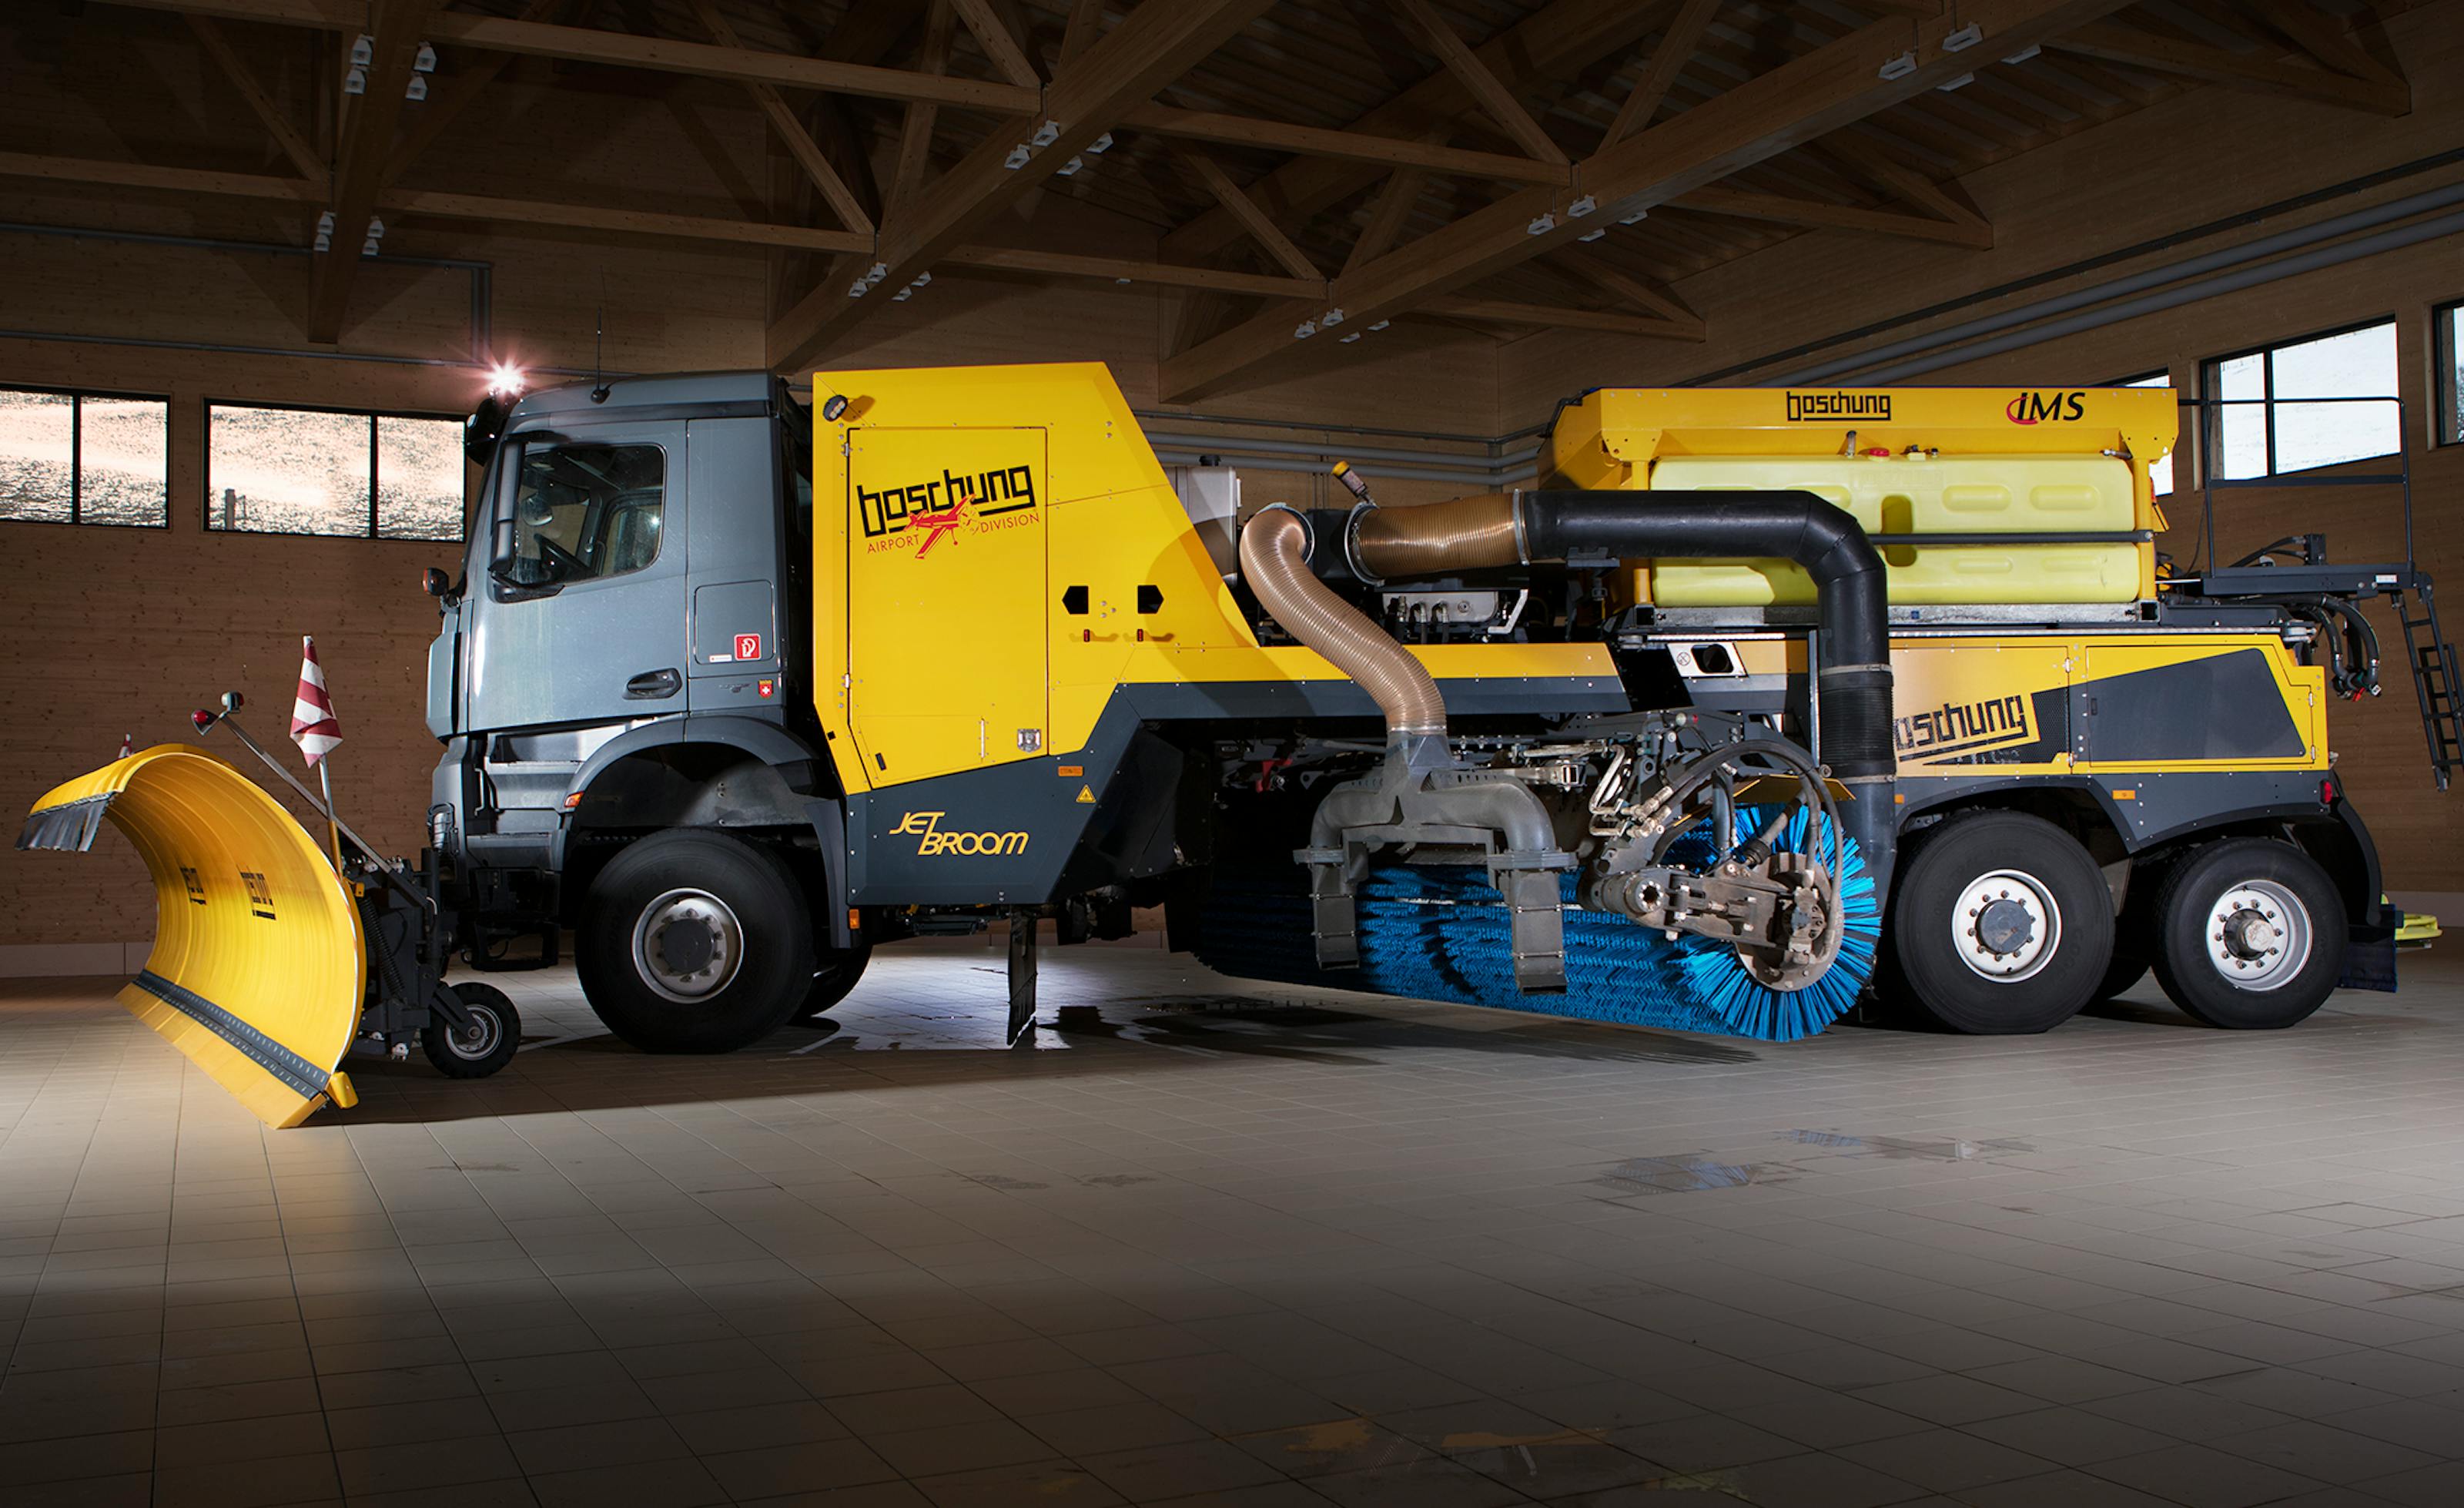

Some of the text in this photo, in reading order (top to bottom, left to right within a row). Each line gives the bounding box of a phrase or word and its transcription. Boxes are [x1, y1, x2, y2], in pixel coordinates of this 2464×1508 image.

[1786, 391, 1891, 421] boschung
[856, 465, 1036, 538] boschung
[867, 511, 1040, 554] AIRPORT DIVISION
[1893, 695, 2029, 762] oschung
[889, 811, 946, 835] JET
[918, 832, 1029, 856] BROOM
